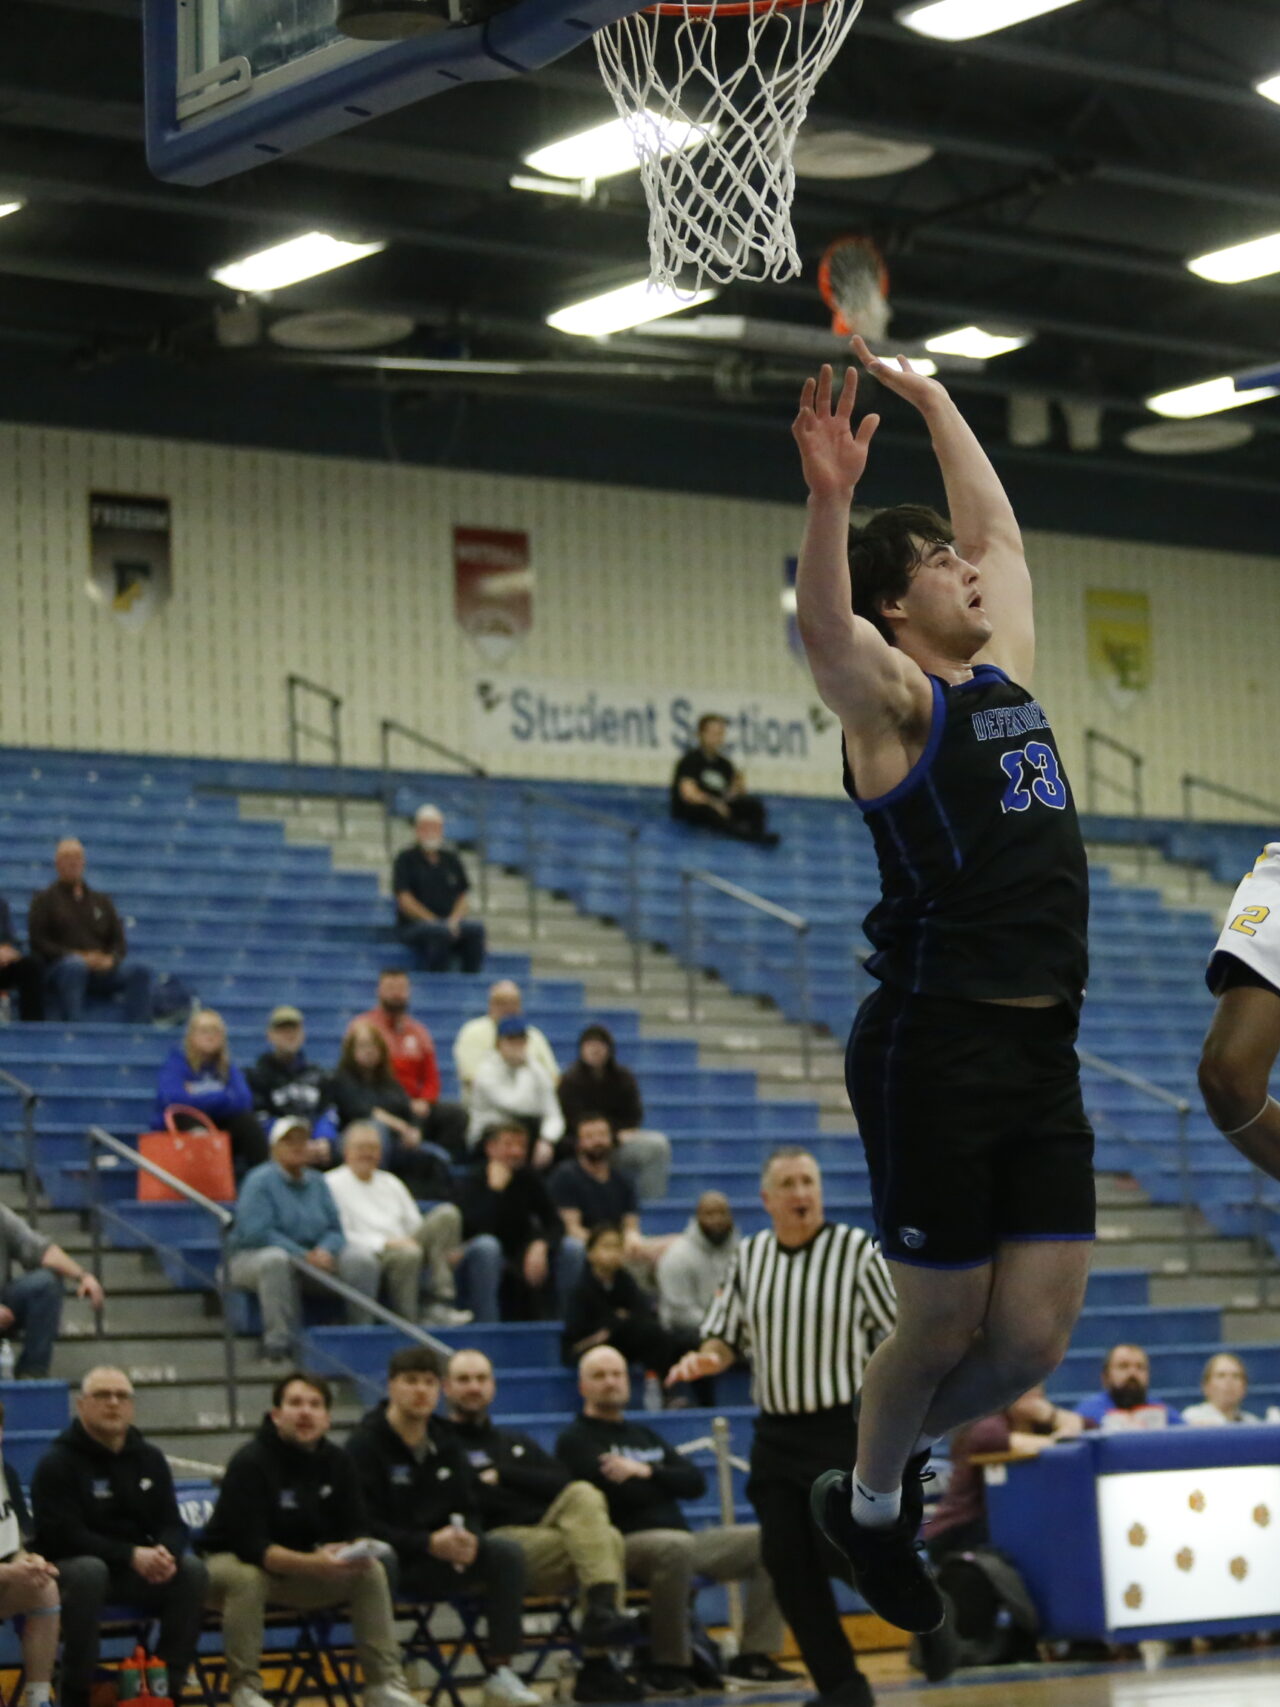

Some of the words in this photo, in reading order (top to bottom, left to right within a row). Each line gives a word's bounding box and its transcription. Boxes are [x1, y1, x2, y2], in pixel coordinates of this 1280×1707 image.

[511, 688, 657, 750] Student
[671, 697, 808, 756] Sction
[1000, 741, 1067, 814] 23
[1228, 905, 1271, 937] 2
